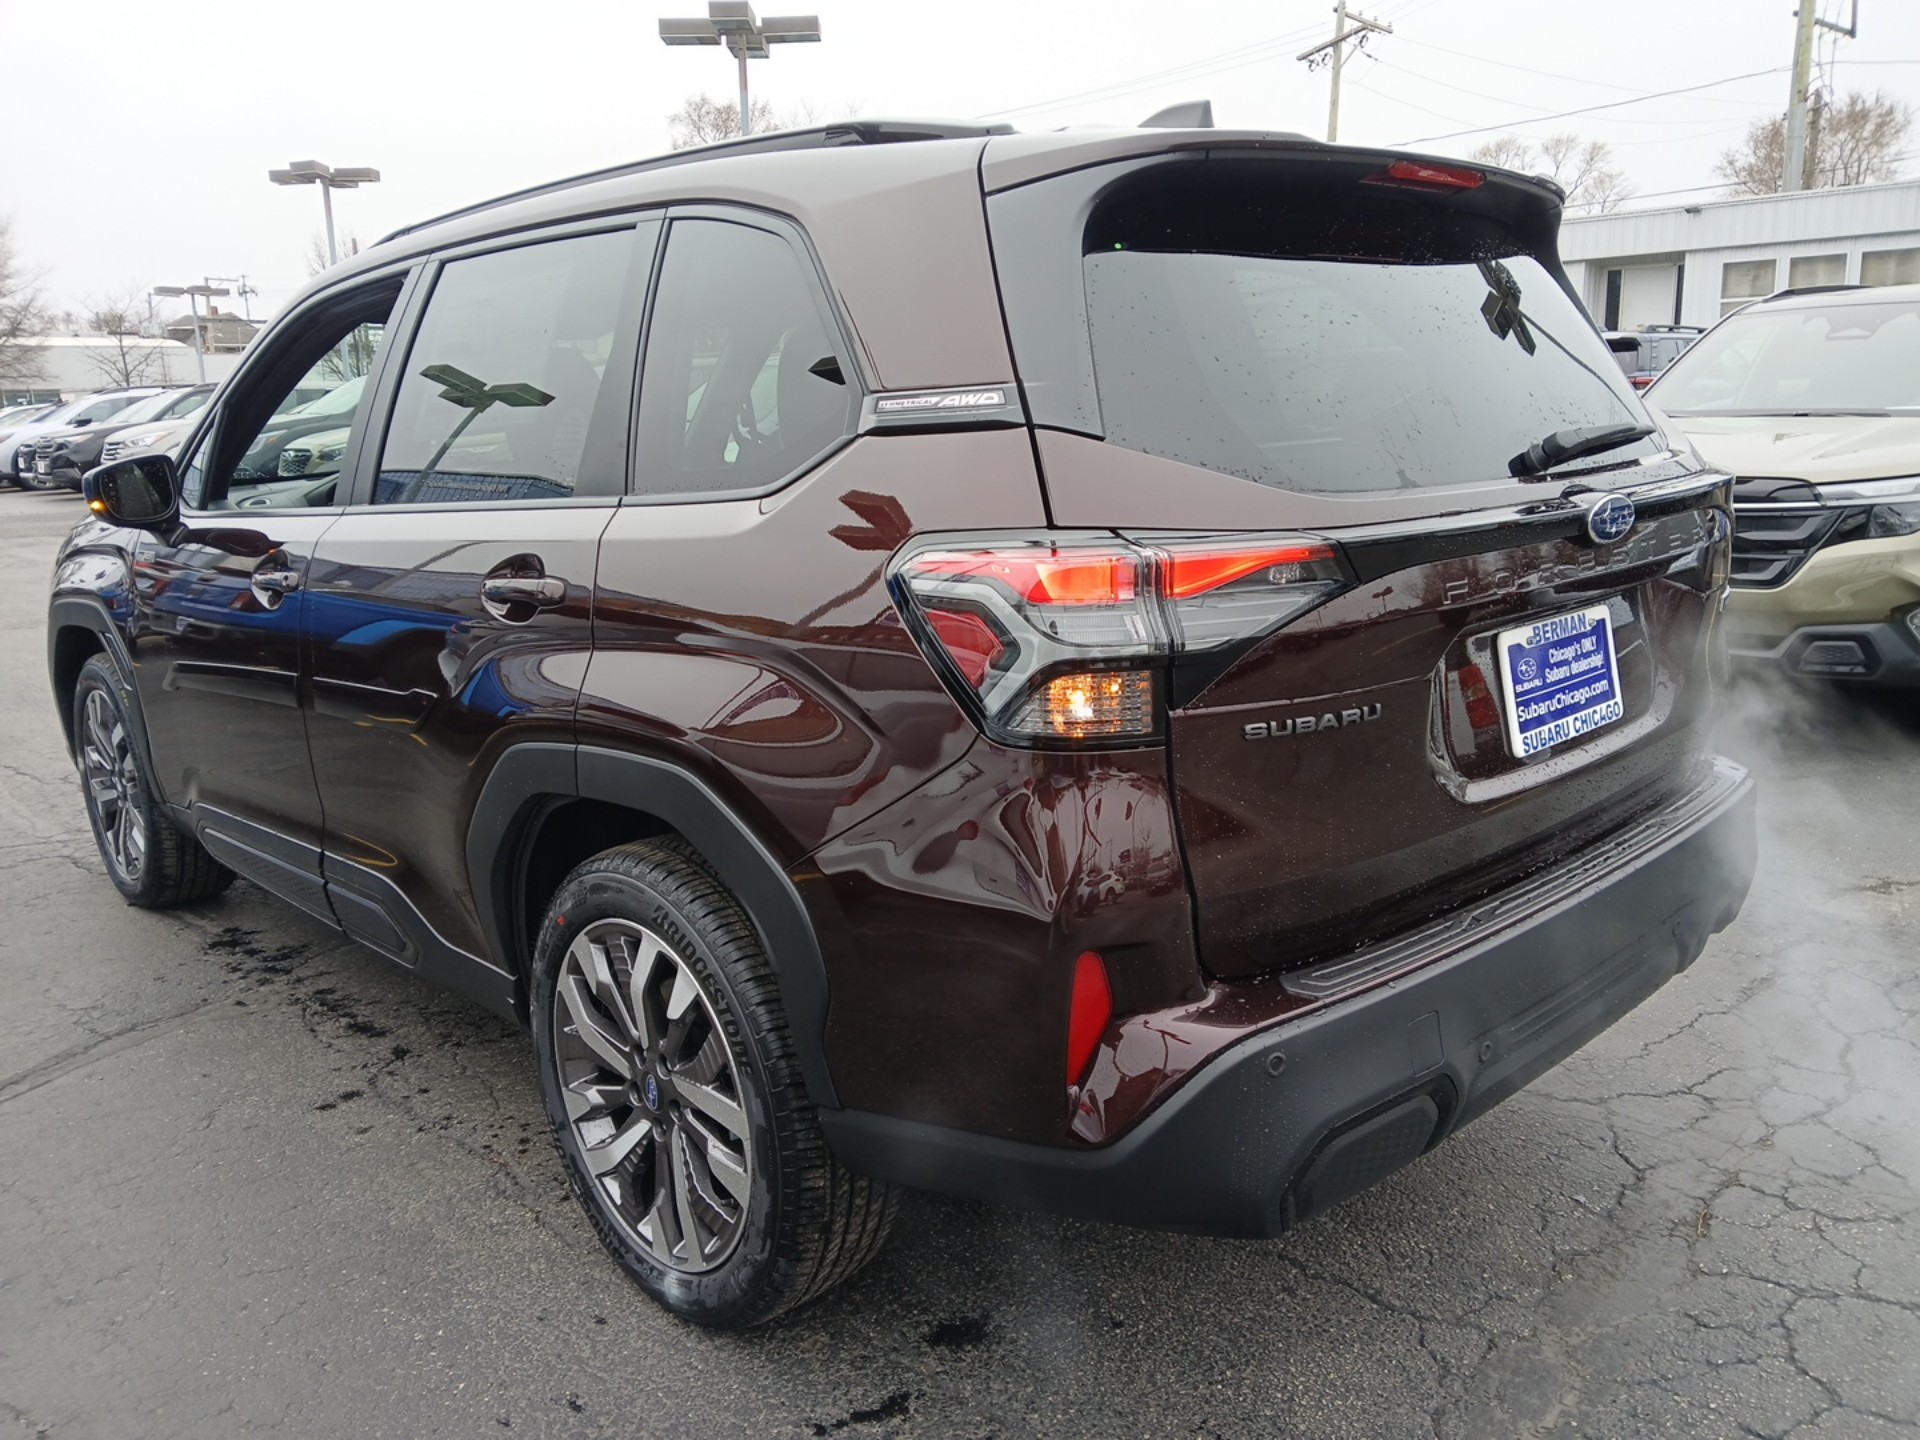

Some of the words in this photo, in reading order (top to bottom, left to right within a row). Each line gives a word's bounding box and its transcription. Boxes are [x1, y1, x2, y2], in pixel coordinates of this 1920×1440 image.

[937, 393, 1001, 407] AWD
[1532, 613, 1587, 645] BERMAN
[1548, 641, 1581, 664] Chicago's
[1581, 636, 1597, 653] ONLY
[1515, 678, 1543, 692] SUBARU
[1545, 665, 1570, 683] Subaru
[1518, 679, 1609, 722] SubaruChicago.com
[1243, 703, 1382, 740] SUBARU
[1522, 720, 1570, 754] SUBARU
[1572, 701, 1621, 734] CHICAGO
